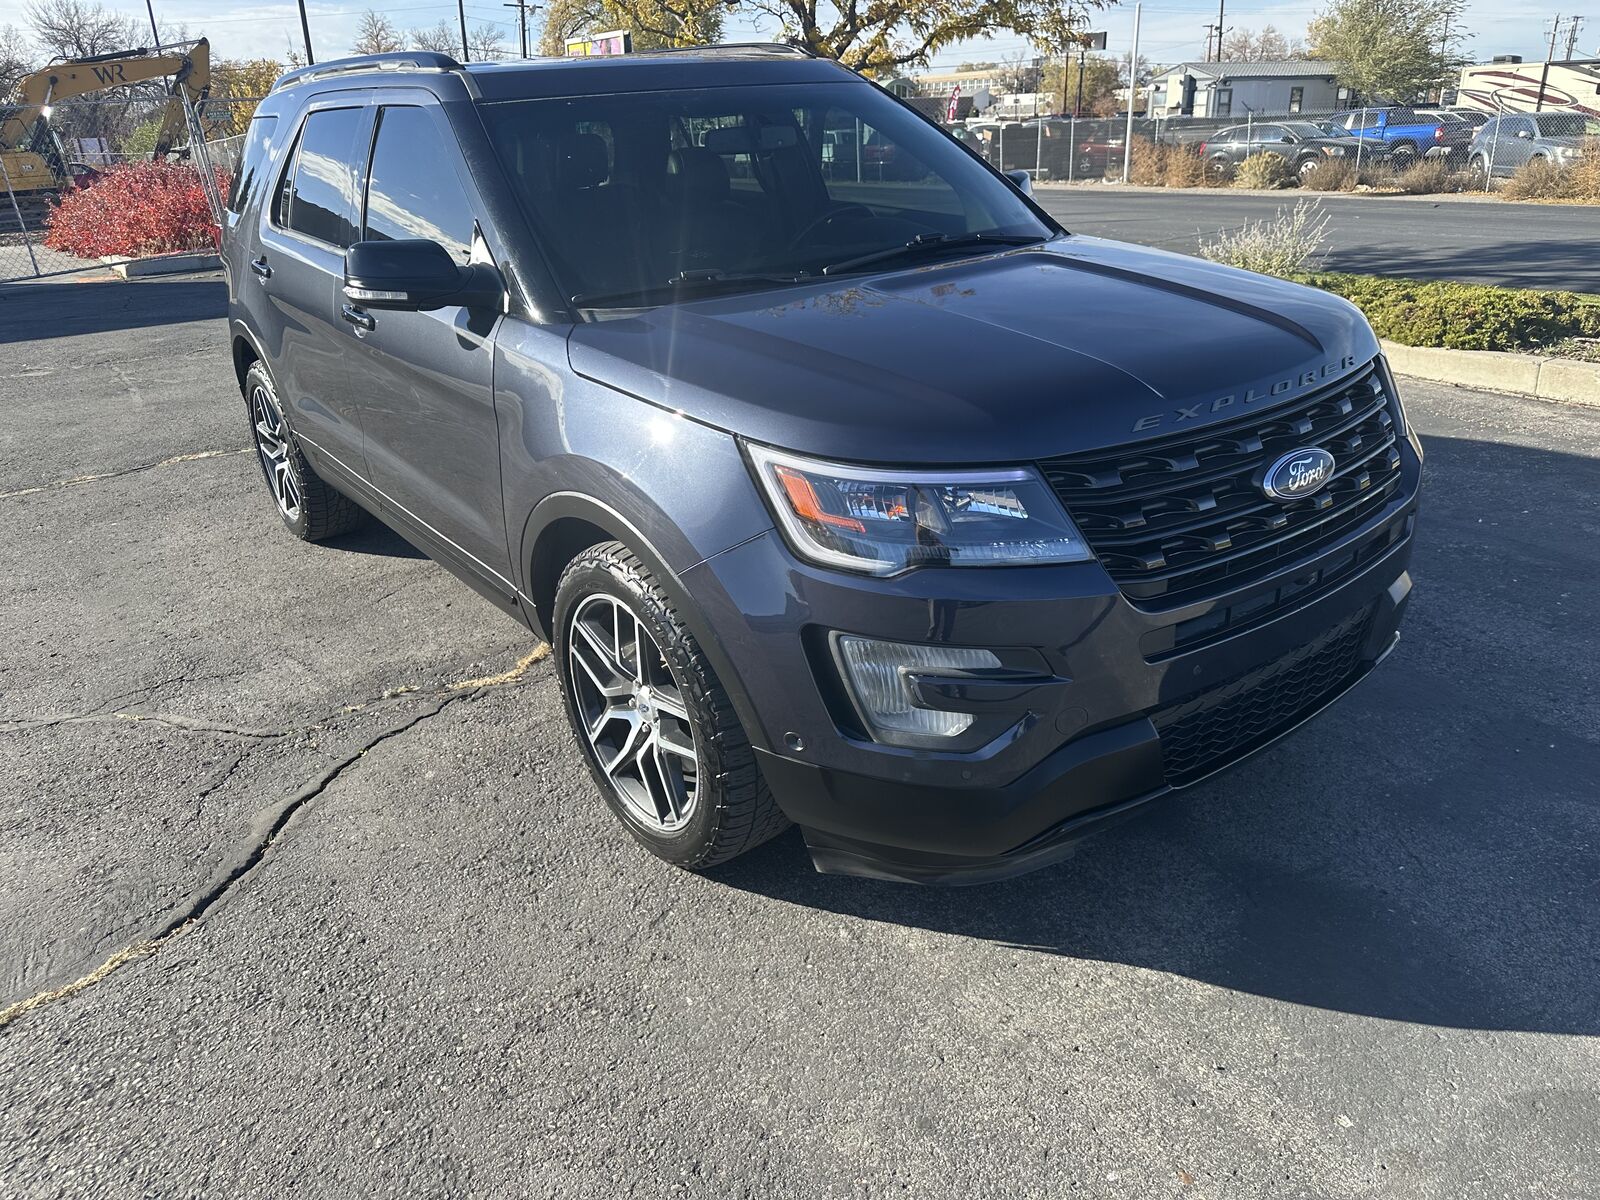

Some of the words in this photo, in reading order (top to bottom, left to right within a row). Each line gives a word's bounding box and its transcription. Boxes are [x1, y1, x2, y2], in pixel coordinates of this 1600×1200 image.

[91, 63, 128, 84] WR
[1132, 356, 1356, 433] EXPLORER
[1289, 456, 1324, 491] Ford
